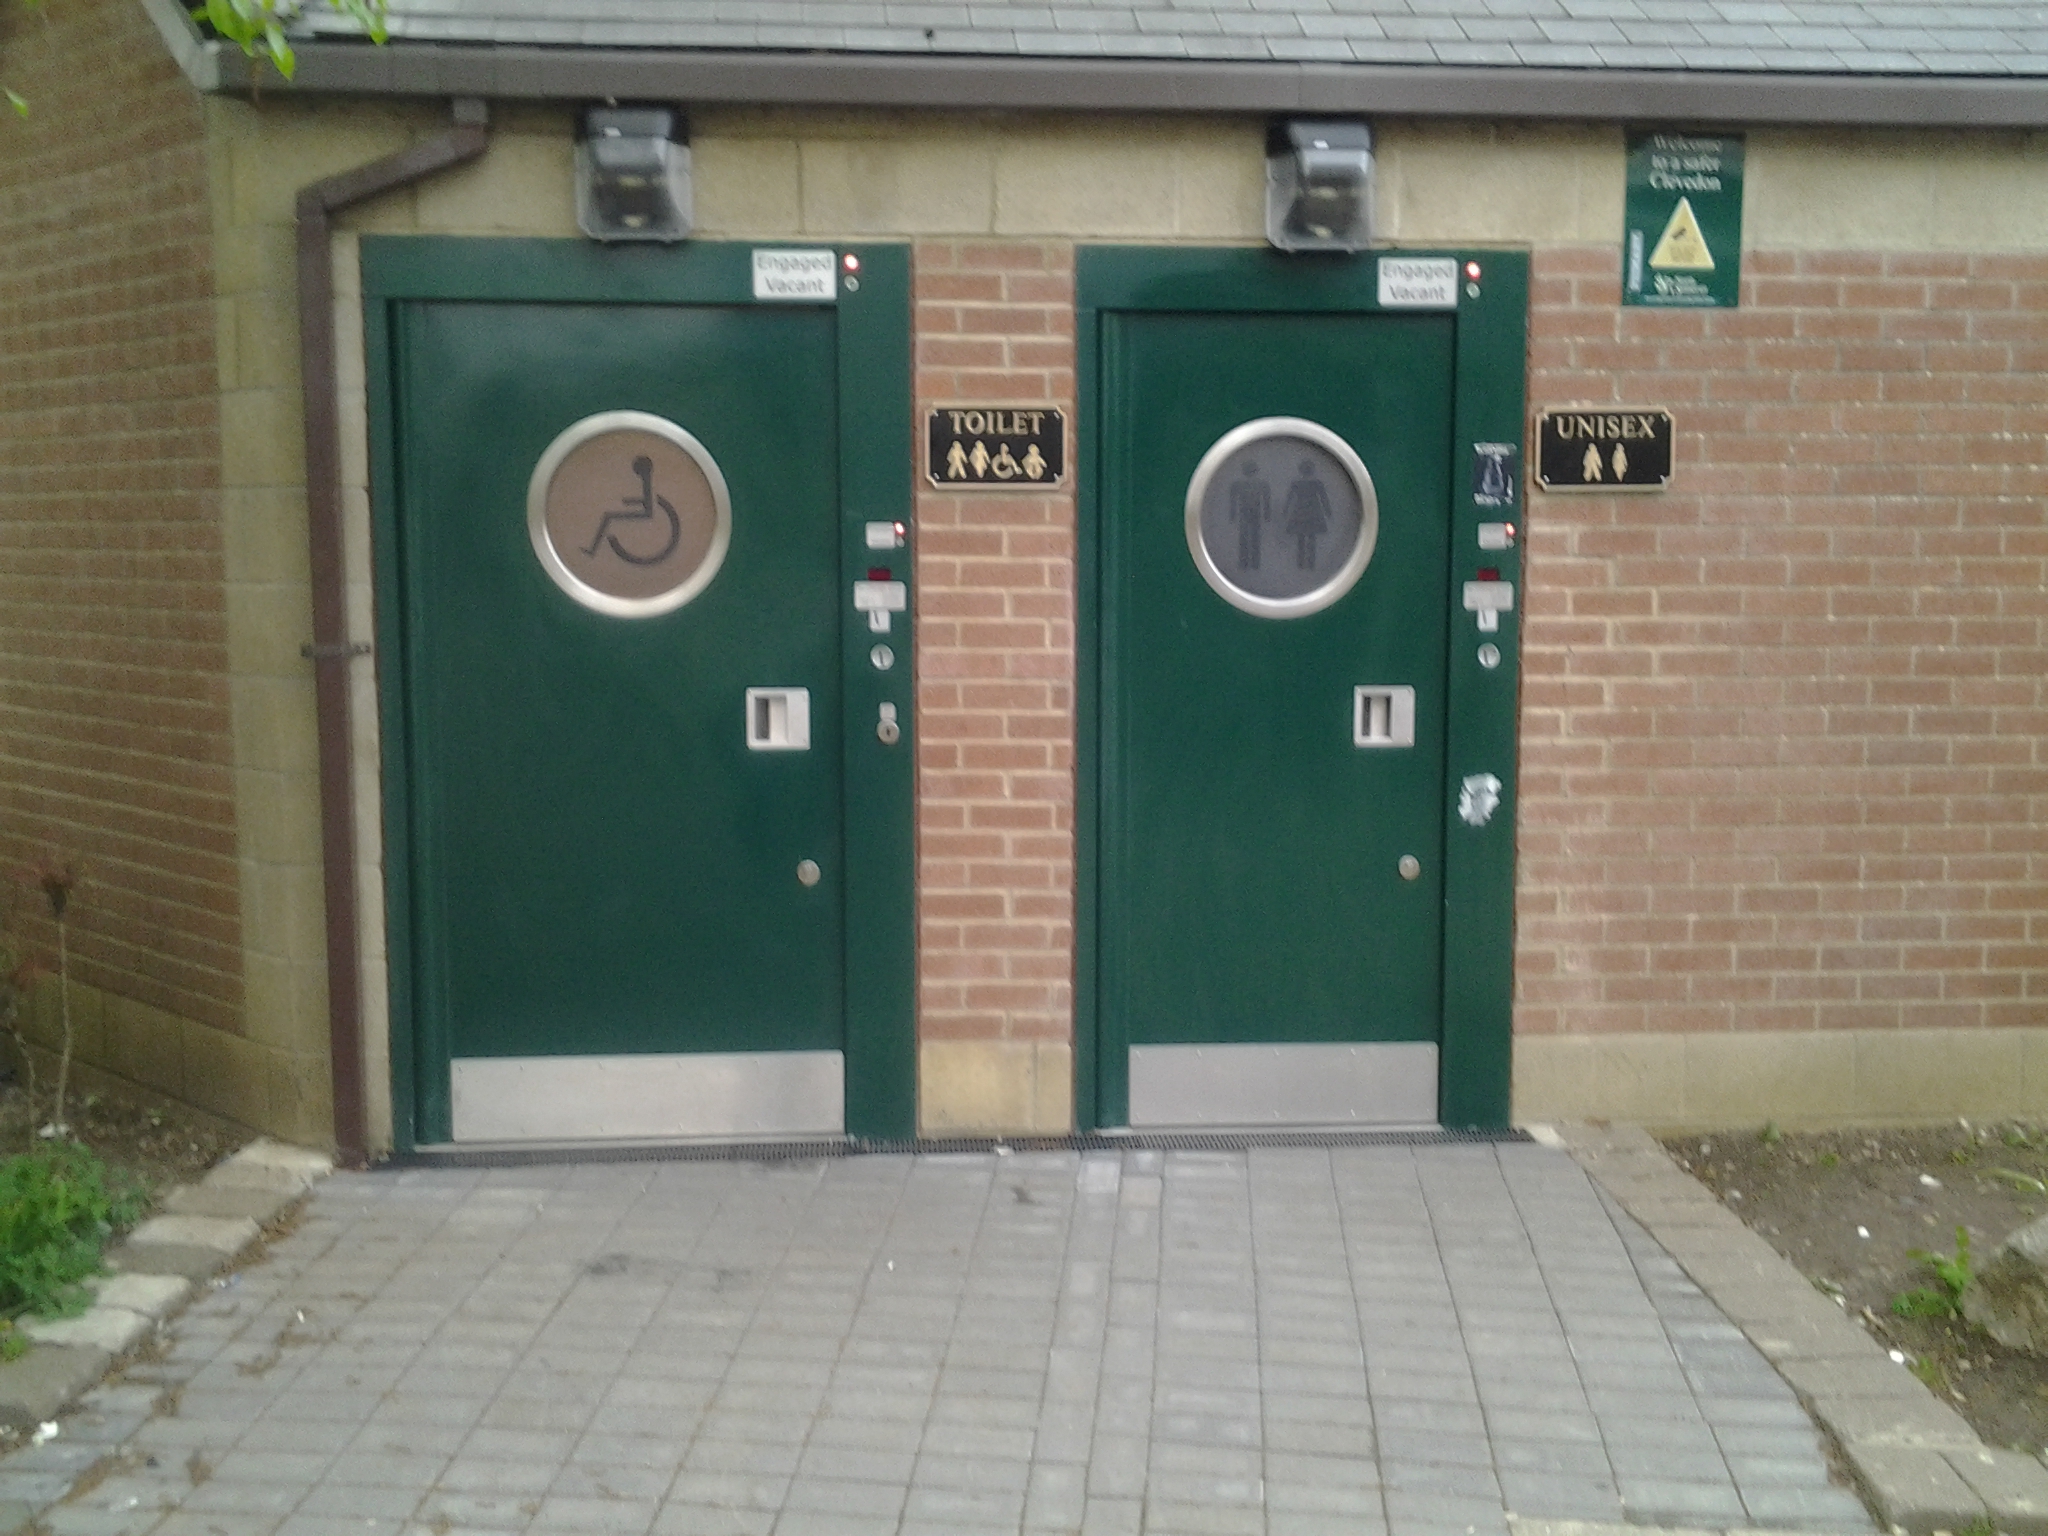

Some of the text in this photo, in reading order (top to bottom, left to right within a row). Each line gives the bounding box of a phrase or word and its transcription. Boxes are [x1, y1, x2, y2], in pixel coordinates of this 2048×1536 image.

[764, 275, 825, 294] Vacant
[1388, 284, 1446, 301] Vacant
[947, 410, 1046, 436] TOILET
[1556, 415, 1656, 439] UNISEX
